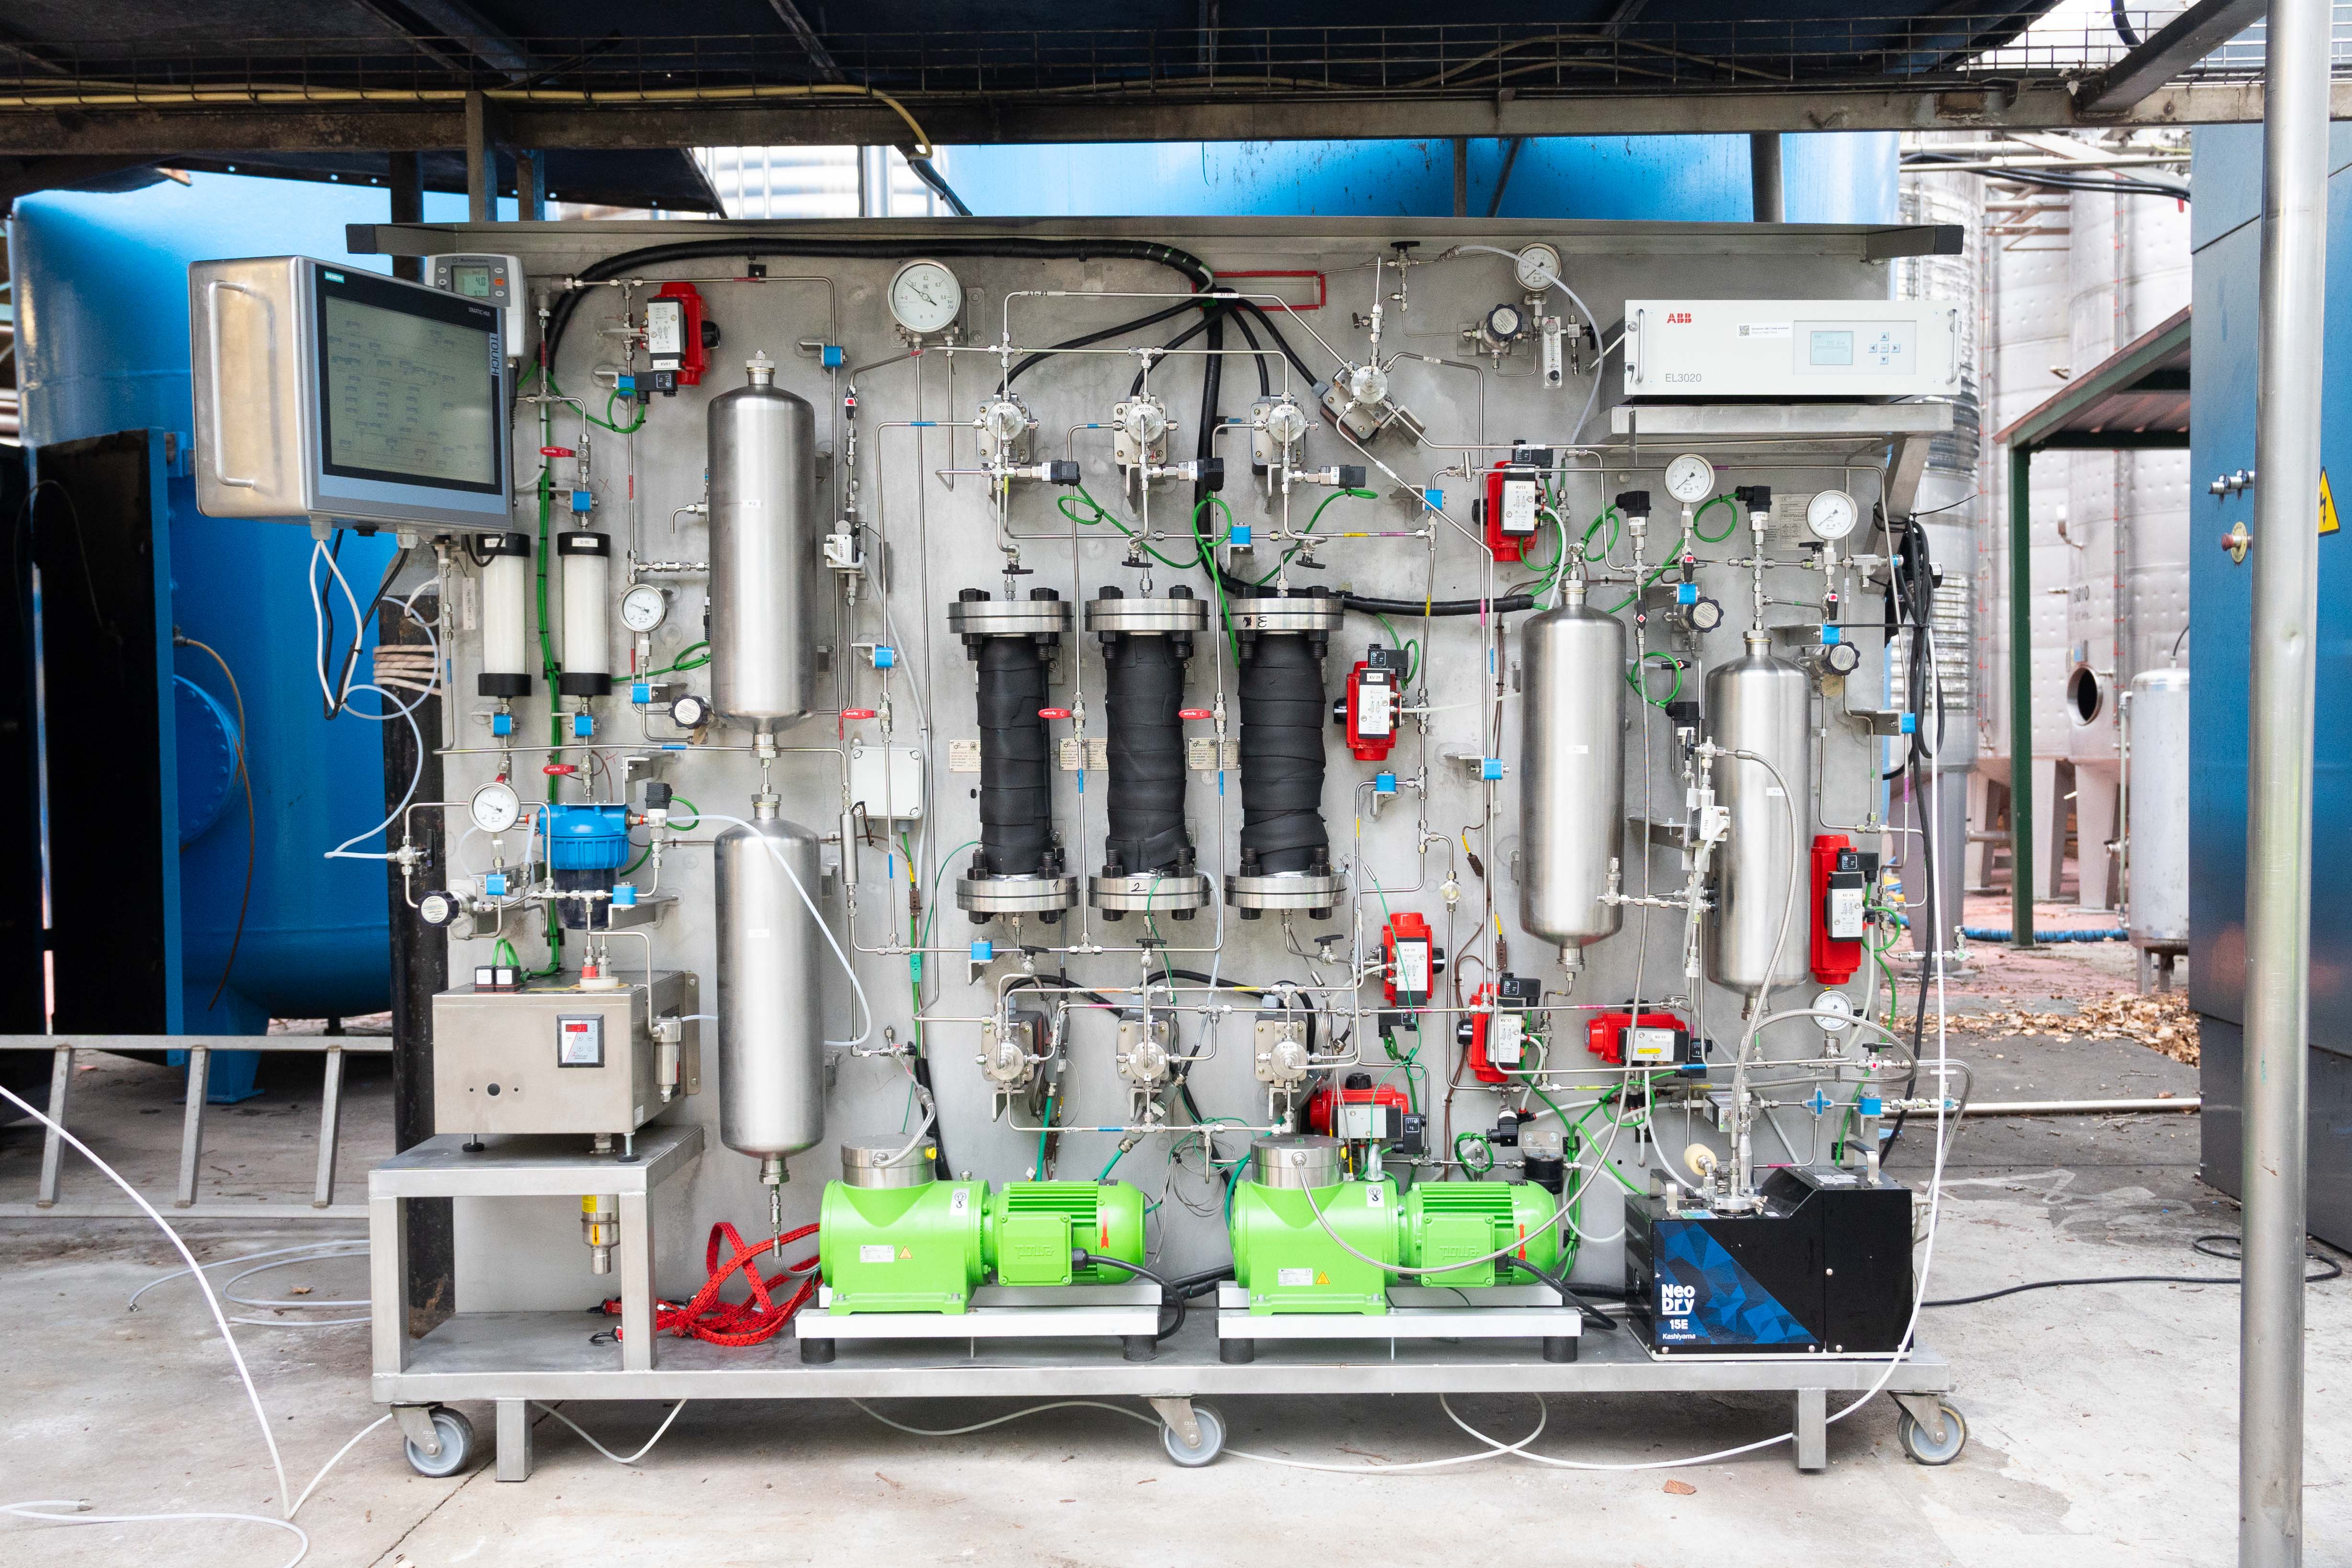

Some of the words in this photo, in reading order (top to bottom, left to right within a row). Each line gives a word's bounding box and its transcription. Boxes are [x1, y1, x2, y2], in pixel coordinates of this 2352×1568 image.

[1667, 313, 1692, 323] ABB
[491, 334, 499, 375] TOUCH
[1666, 373, 1701, 382] EL3020
[1130, 882, 1147, 892] 2
[1661, 1284, 1695, 1298] Neo
[1662, 1298, 1695, 1315] Dry
[1669, 1319, 1688, 1329] 15E
